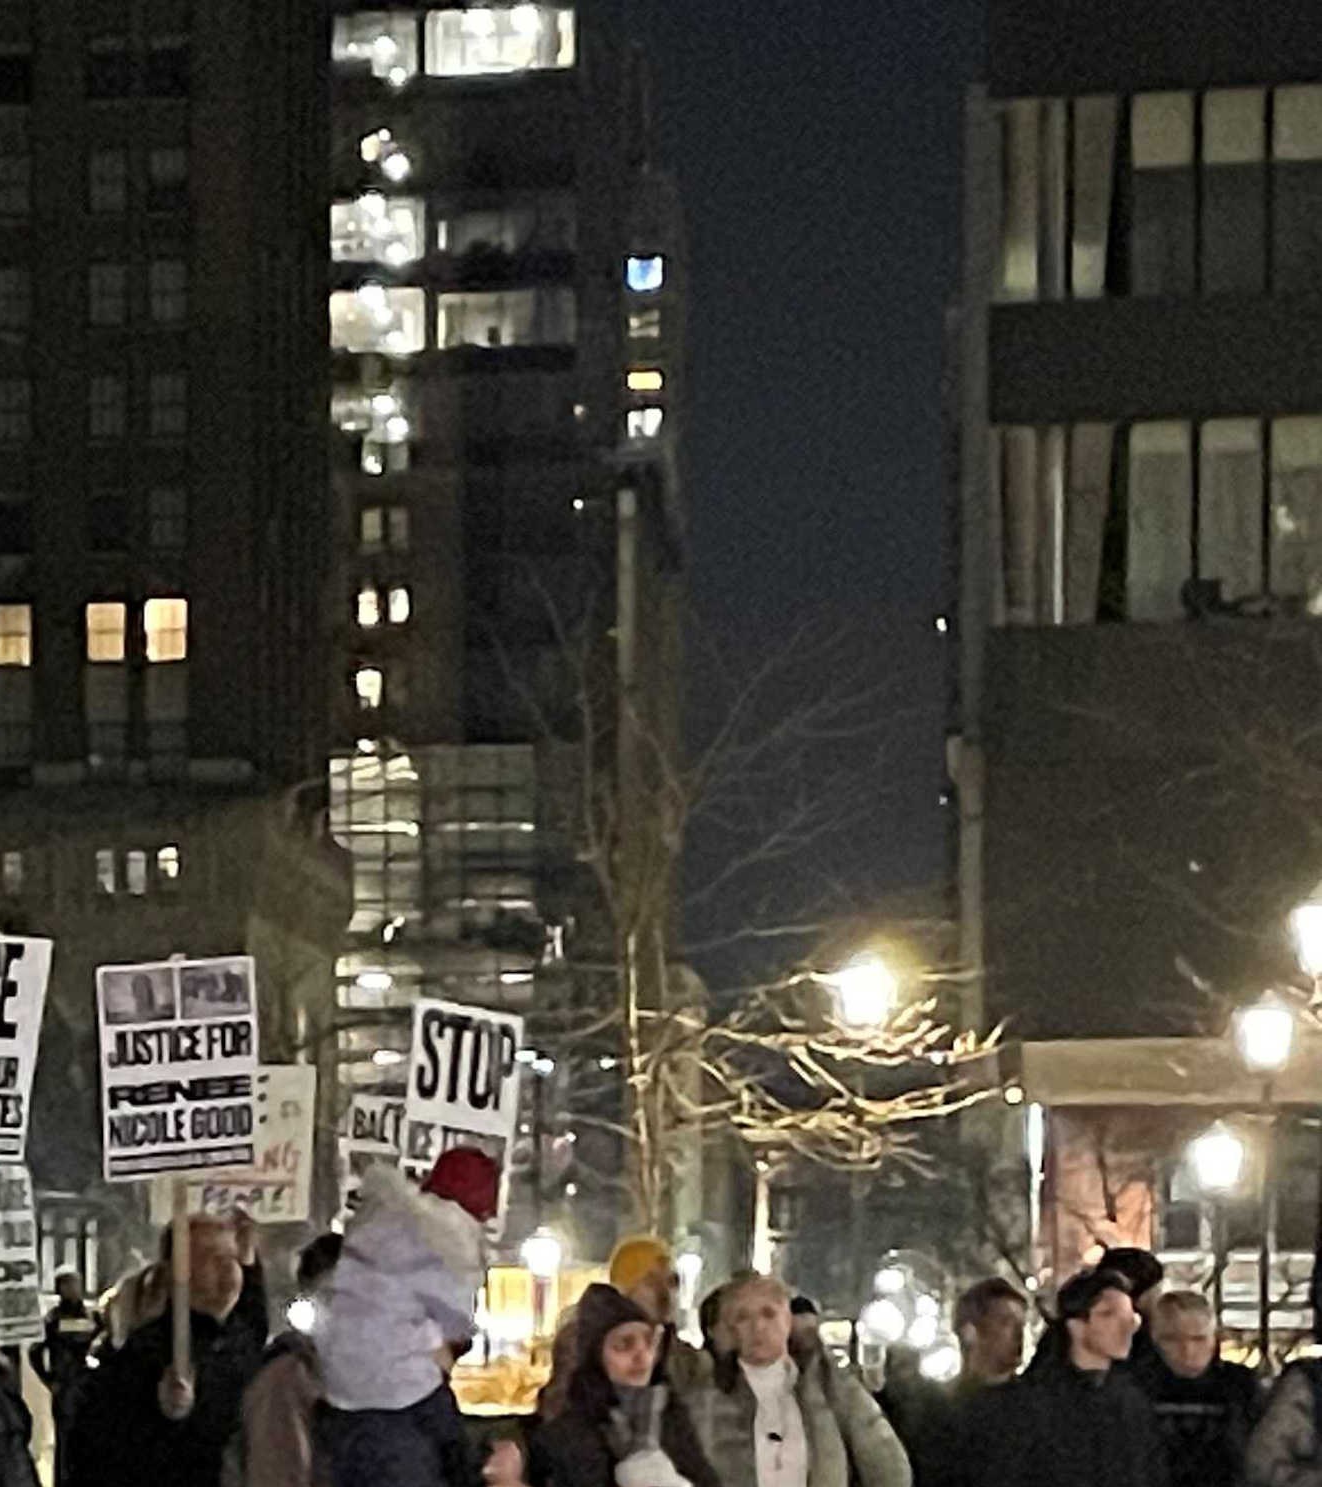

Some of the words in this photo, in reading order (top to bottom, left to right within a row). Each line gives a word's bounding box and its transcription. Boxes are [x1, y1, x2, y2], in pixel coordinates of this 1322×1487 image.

[108, 1026, 202, 1069] JUSTICE
[207, 1021, 252, 1060] FOR
[417, 1008, 516, 1110] STOP
[108, 1075, 251, 1109] RENEE
[109, 1109, 186, 1147] NICOLE
[190, 1103, 252, 1140] GOOD
